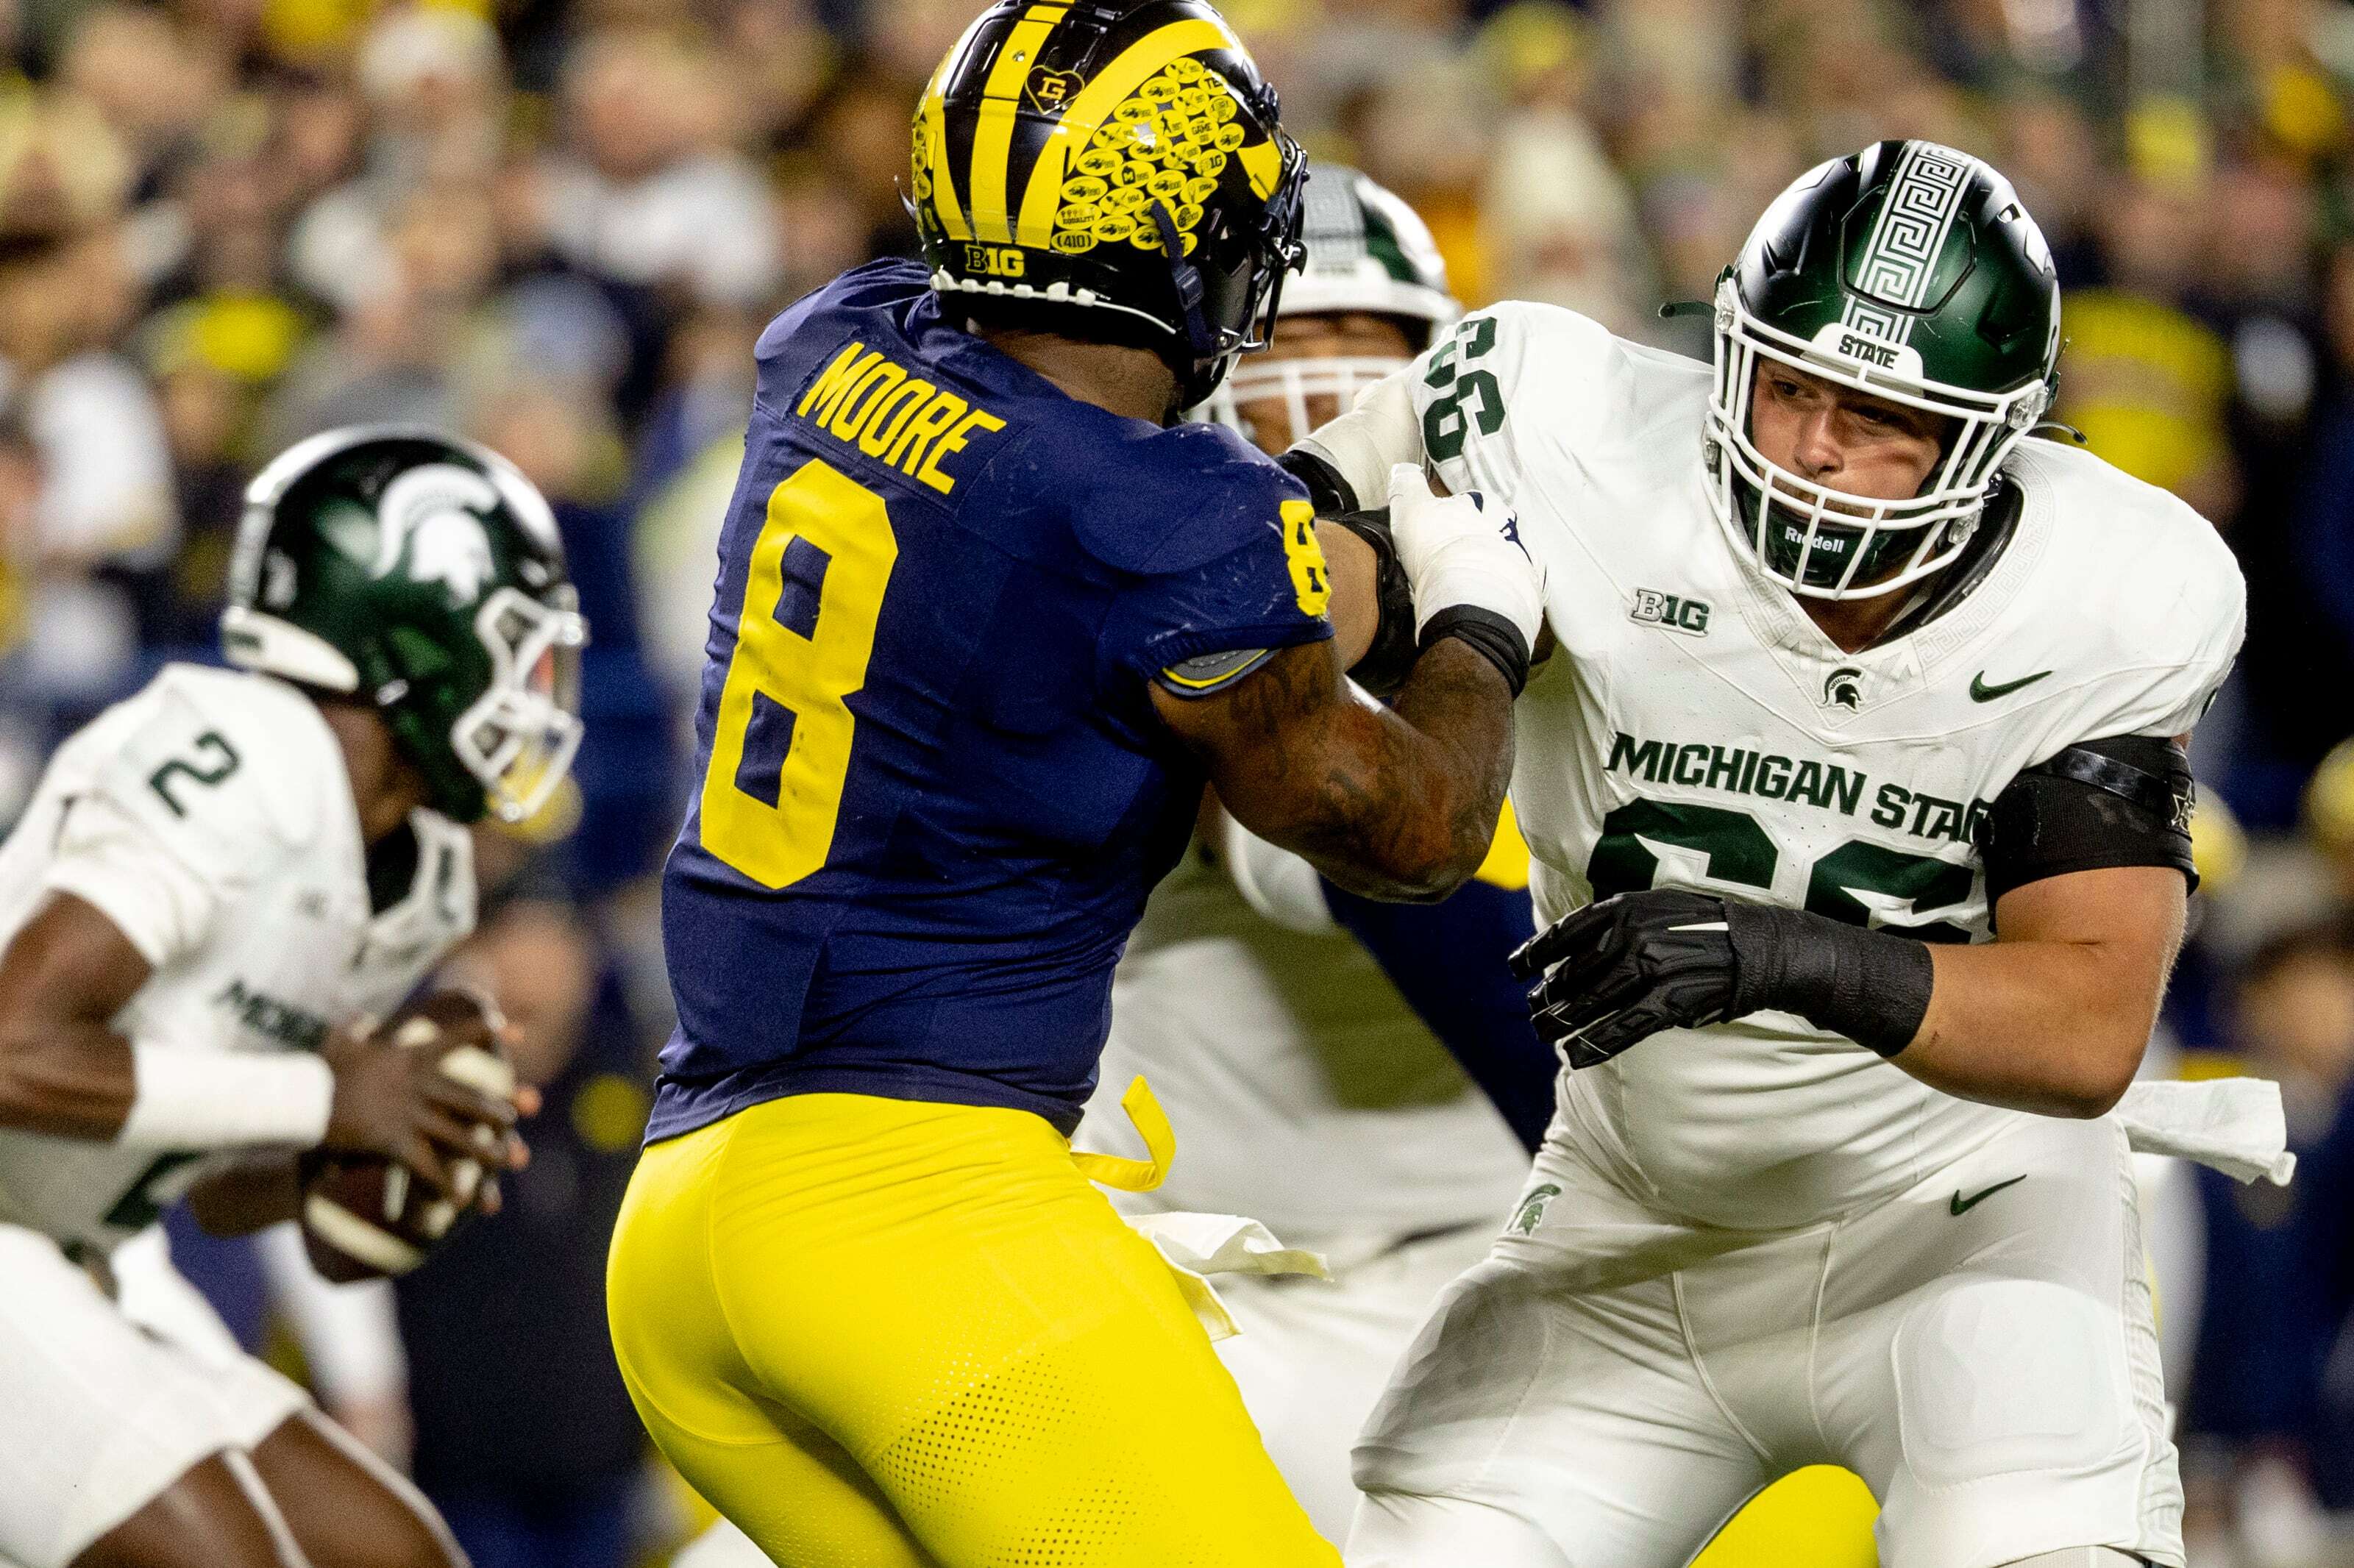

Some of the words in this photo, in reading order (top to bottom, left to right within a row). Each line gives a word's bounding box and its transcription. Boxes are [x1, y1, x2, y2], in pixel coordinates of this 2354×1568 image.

[1192, 122, 1213, 135] GAME
[1056, 234, 1092, 249] (410)
[1062, 215, 1095, 225] EQUALITY
[1838, 334, 1900, 370] STATE
[797, 341, 1007, 495] MOORE
[1279, 499, 1331, 616] 8
[700, 457, 899, 890] 8
[149, 729, 241, 819] 2
[1603, 732, 1868, 816] MICHIGAN
[1871, 783, 1996, 844] STAT
